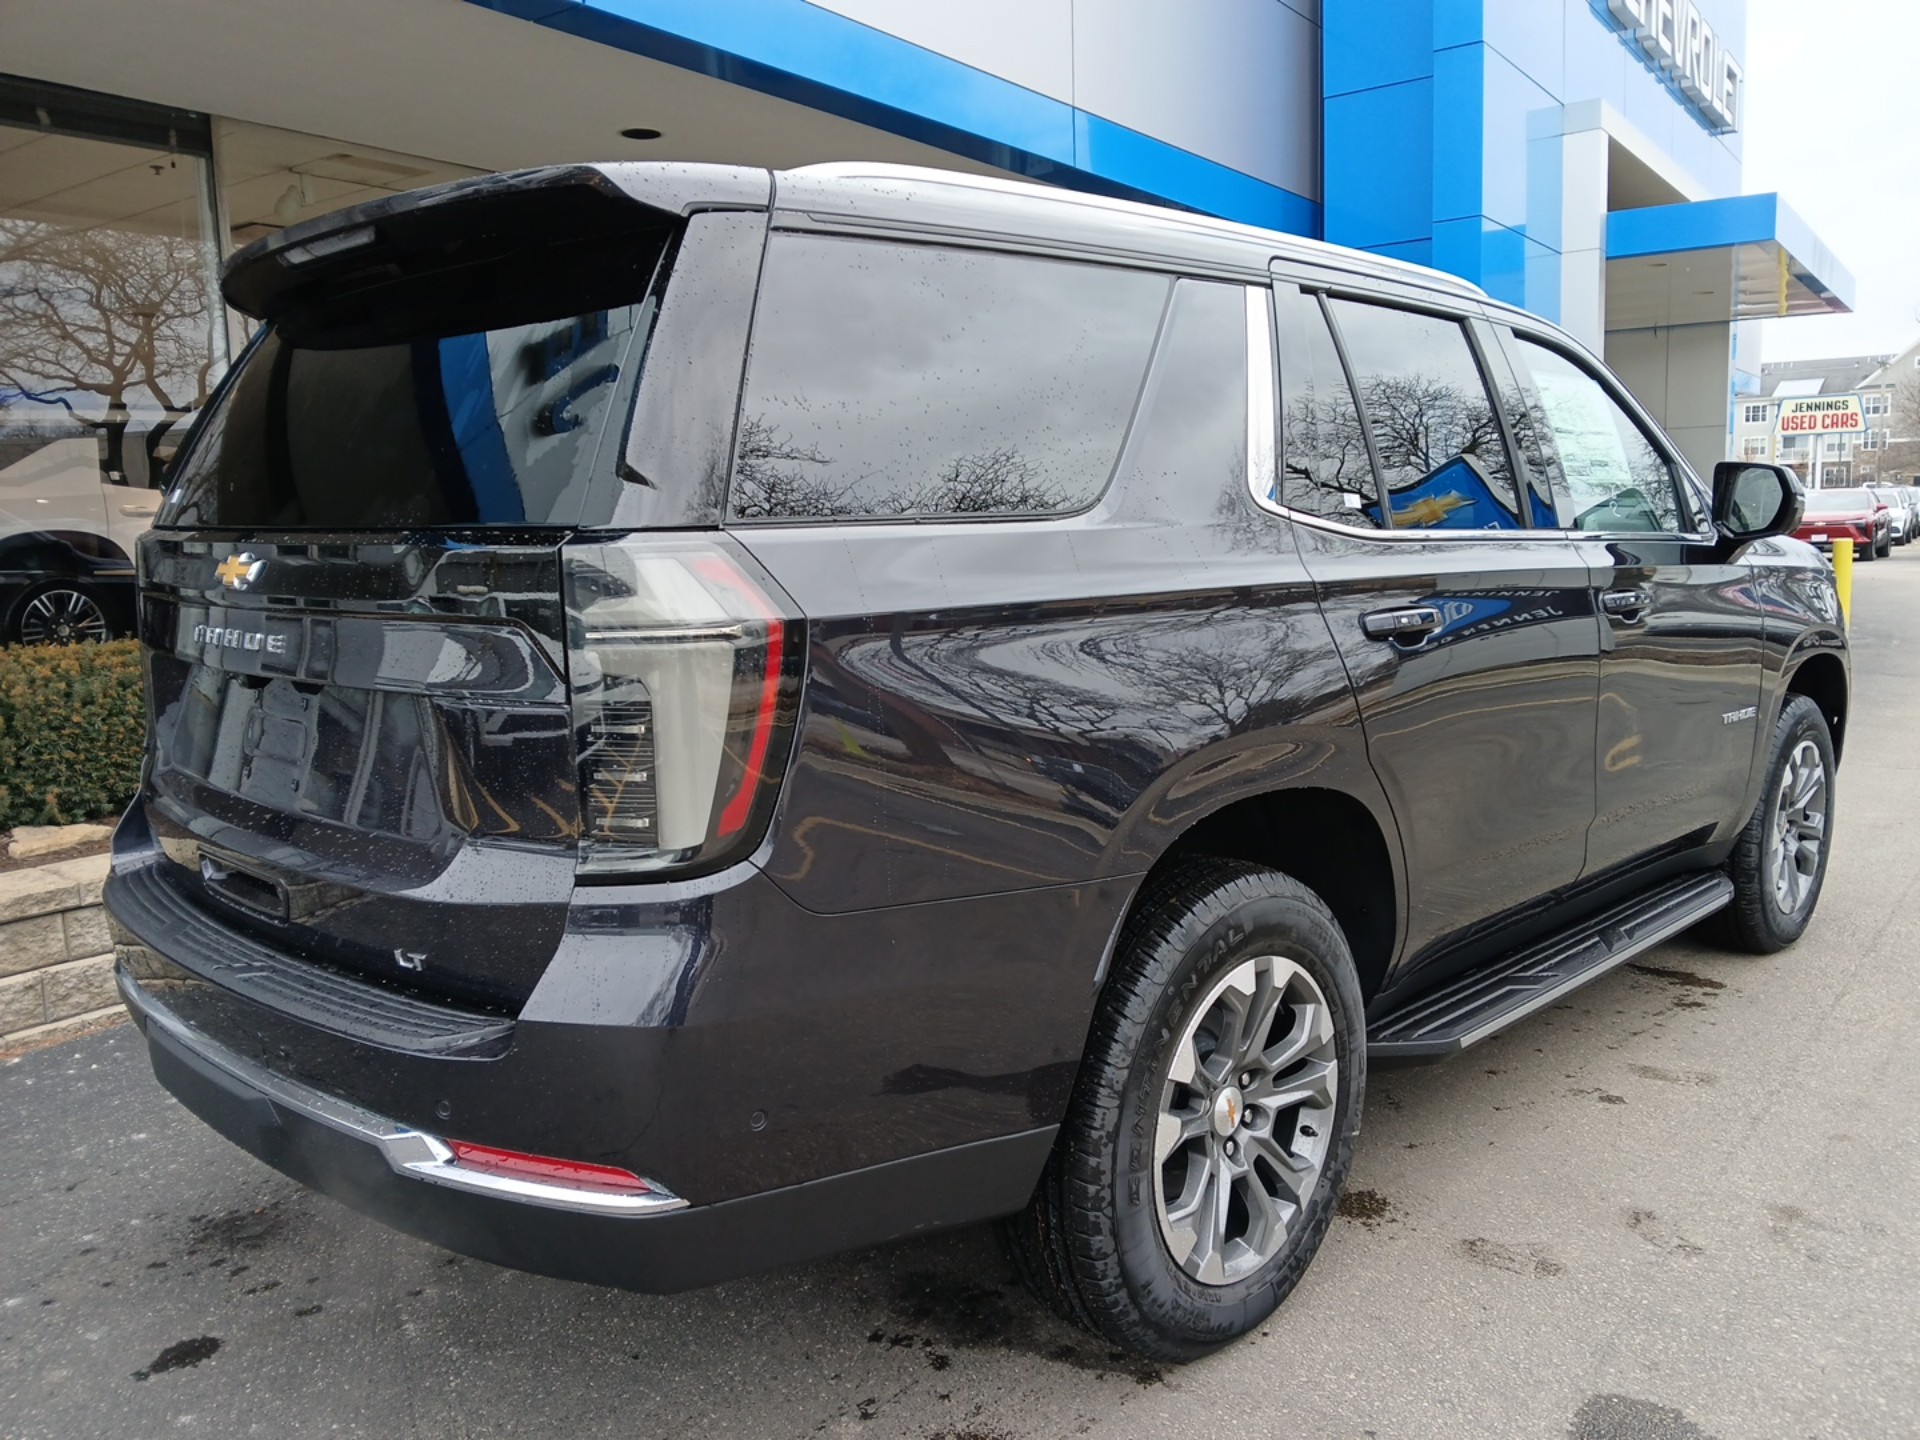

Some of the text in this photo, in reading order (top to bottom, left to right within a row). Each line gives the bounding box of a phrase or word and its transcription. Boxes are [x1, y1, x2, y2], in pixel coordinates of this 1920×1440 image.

[1608, 0, 1744, 134] EVROLET
[1791, 400, 1849, 413] JENNINGS
[1781, 412, 1859, 431] USED CARS
[194, 624, 286, 654] TAHOE
[1721, 706, 1758, 725] TAHOE
[394, 948, 428, 971] LT
